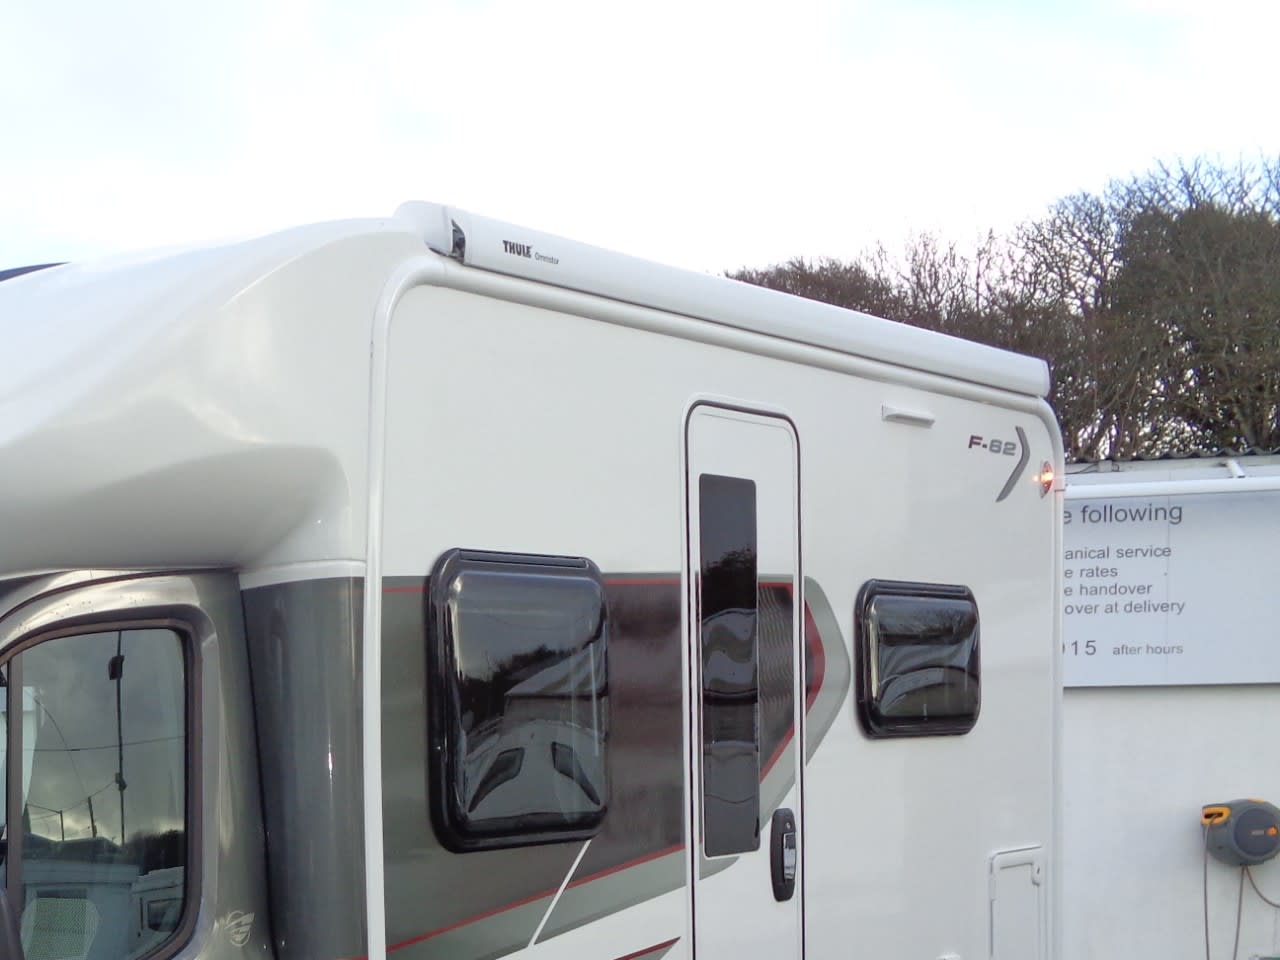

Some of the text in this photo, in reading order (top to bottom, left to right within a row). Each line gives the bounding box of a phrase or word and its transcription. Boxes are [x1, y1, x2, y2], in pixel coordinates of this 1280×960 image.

[503, 240, 532, 258] THULE
[1081, 503, 1183, 525] following
[1116, 545, 1172, 559] service
[1080, 565, 1119, 578] rates
[1080, 583, 1153, 596] handover
[1064, 600, 1186, 616] over at delivery
[1112, 644, 1142, 656] after
[1145, 644, 1185, 655] hours
